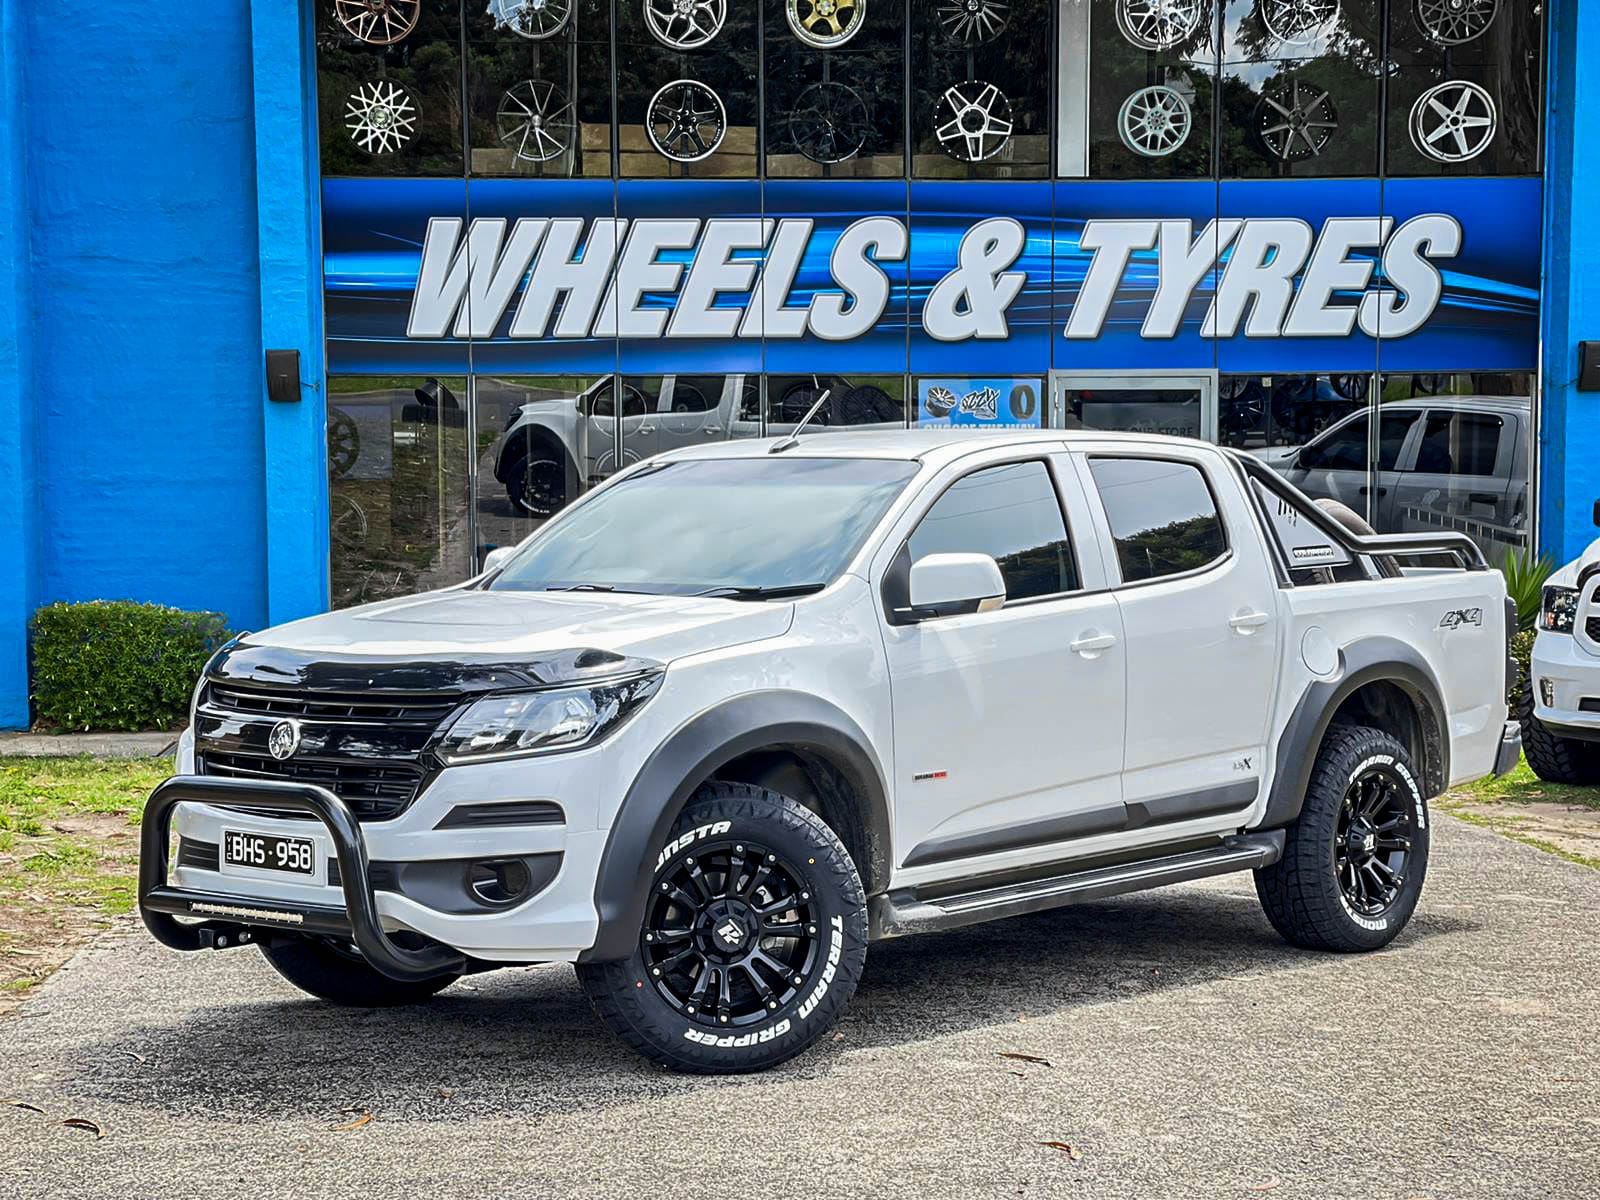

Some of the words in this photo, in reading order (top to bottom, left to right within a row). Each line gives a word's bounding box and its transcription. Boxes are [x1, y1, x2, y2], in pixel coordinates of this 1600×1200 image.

[406, 215, 908, 341] WHEELS
[922, 217, 1028, 341] &
[1063, 213, 1462, 339] TYRES
[797, 914, 843, 1020] TERRAIN
[684, 1018, 792, 1048] GRIPPER
